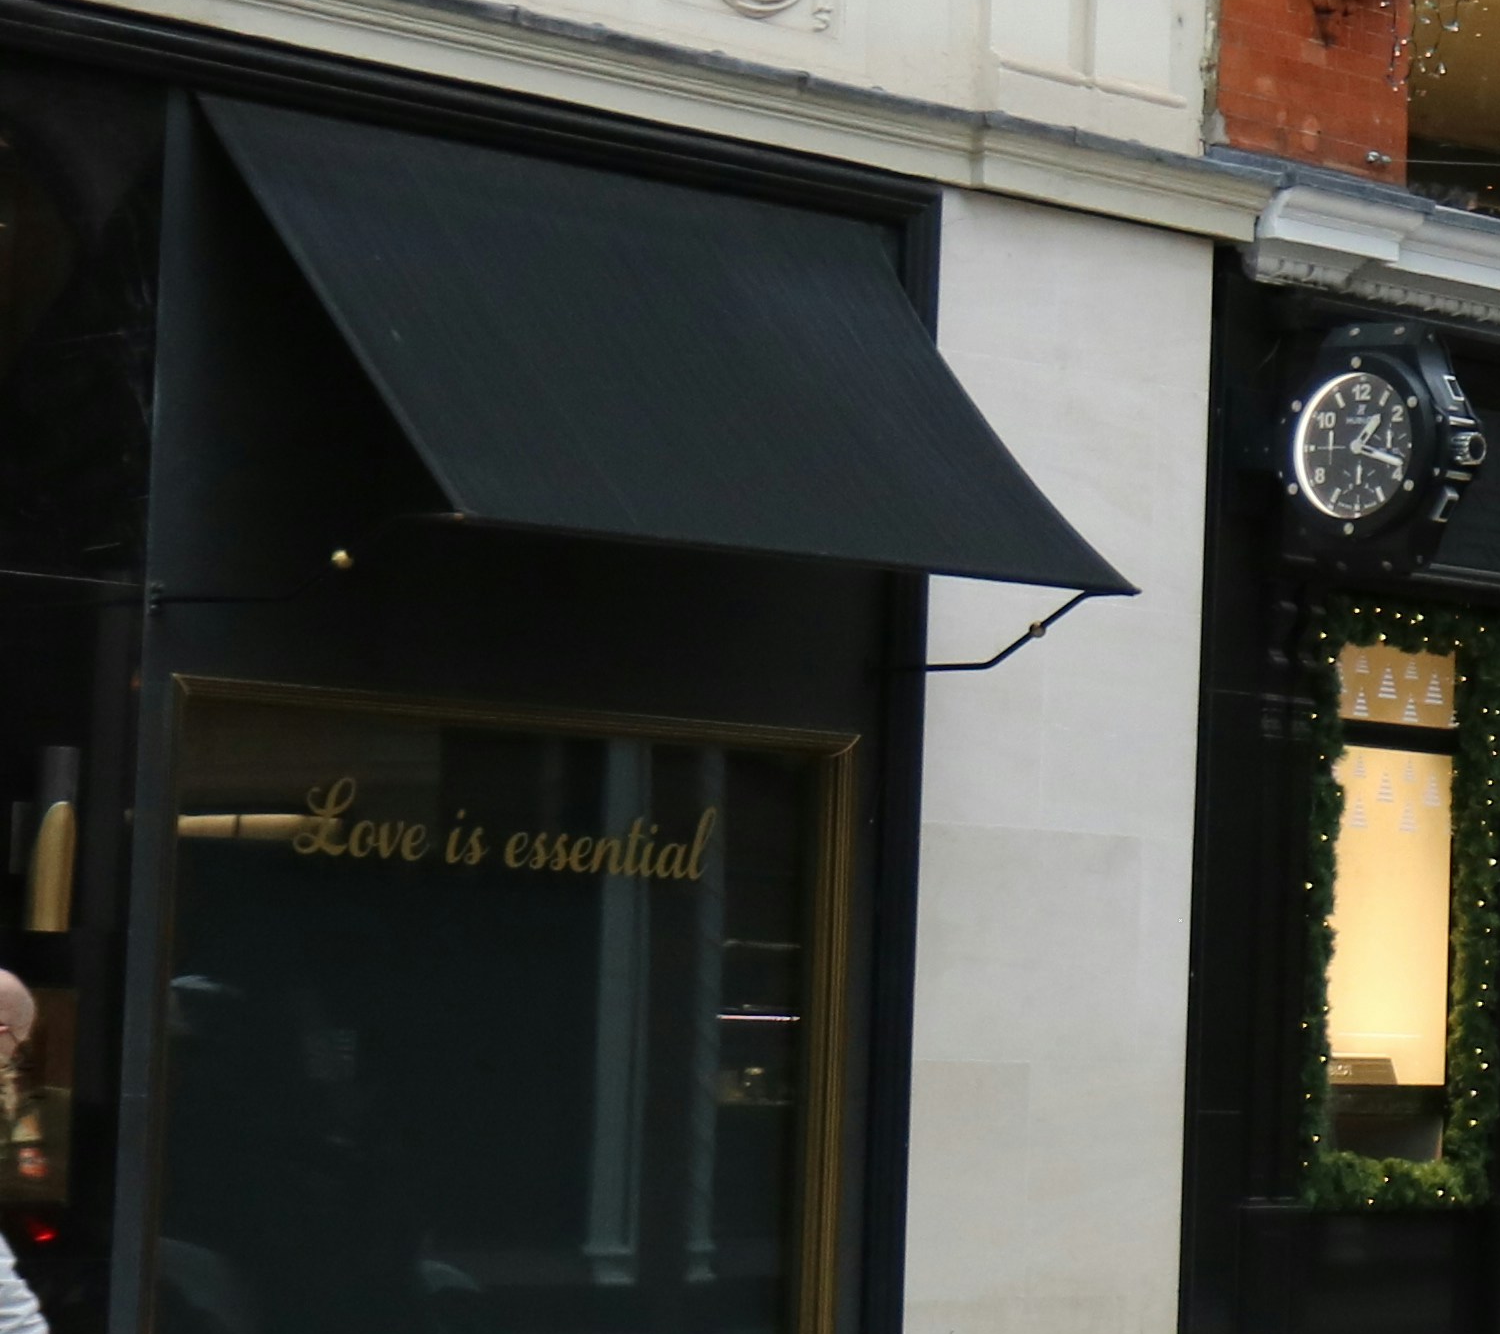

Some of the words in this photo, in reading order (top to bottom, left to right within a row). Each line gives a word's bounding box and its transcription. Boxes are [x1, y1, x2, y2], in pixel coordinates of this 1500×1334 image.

[1352, 383, 1372, 401] 12
[1316, 411, 1337, 430] 10
[1391, 405, 1404, 423] 2
[1314, 467, 1326, 484] 8
[292, 777, 430, 862] Love
[445, 809, 488, 866] is
[505, 806, 718, 881] essential
